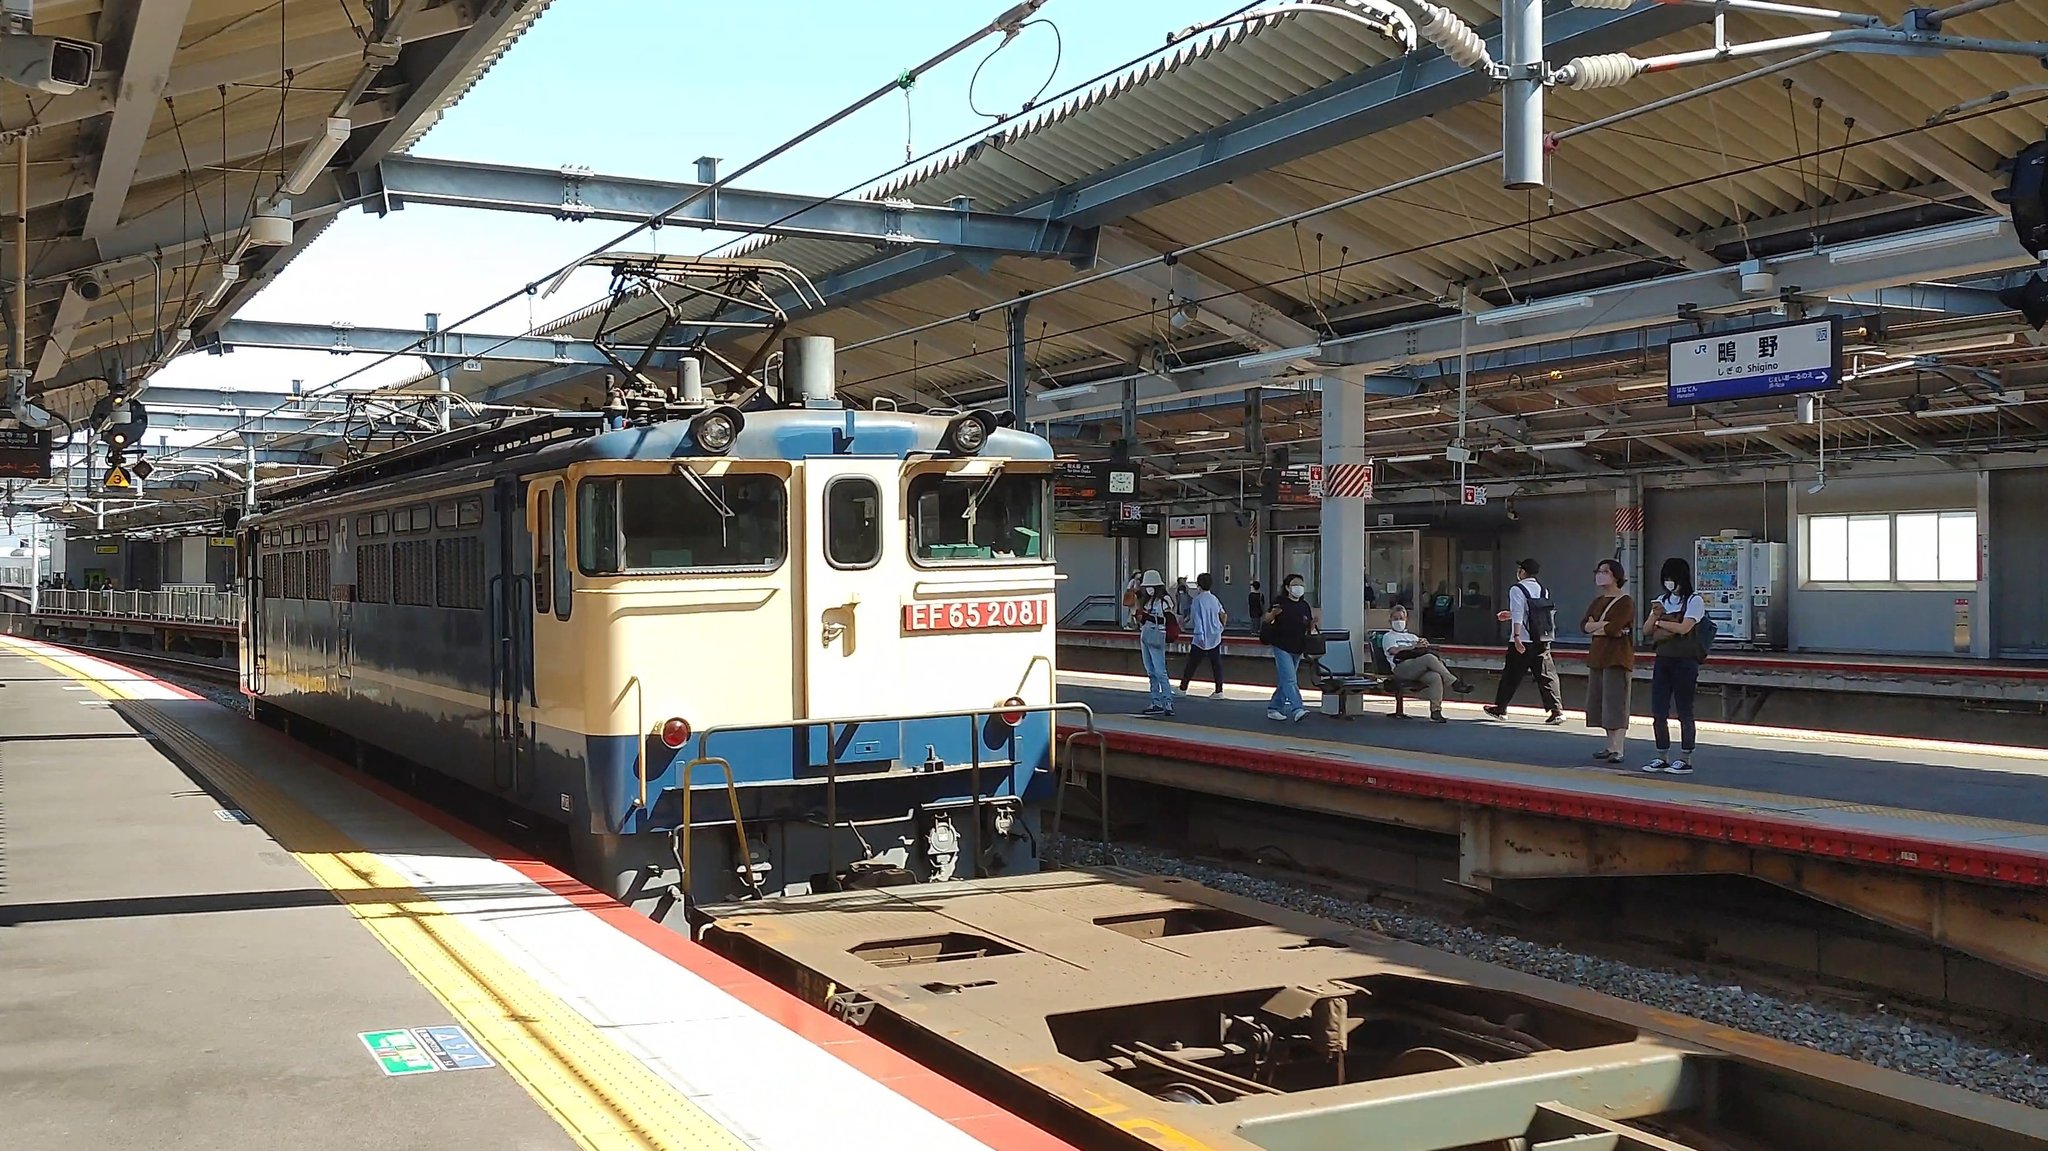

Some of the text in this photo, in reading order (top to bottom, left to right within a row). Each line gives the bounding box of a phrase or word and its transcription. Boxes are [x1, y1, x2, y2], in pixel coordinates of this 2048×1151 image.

[1694, 344, 1707, 355] JR
[1717, 361, 1779, 376] しぎの Shigino
[32, 432, 39, 444] 1
[113, 474, 122, 484] 3
[335, 517, 348, 554] JR
[987, 600, 1043, 626] 2081
